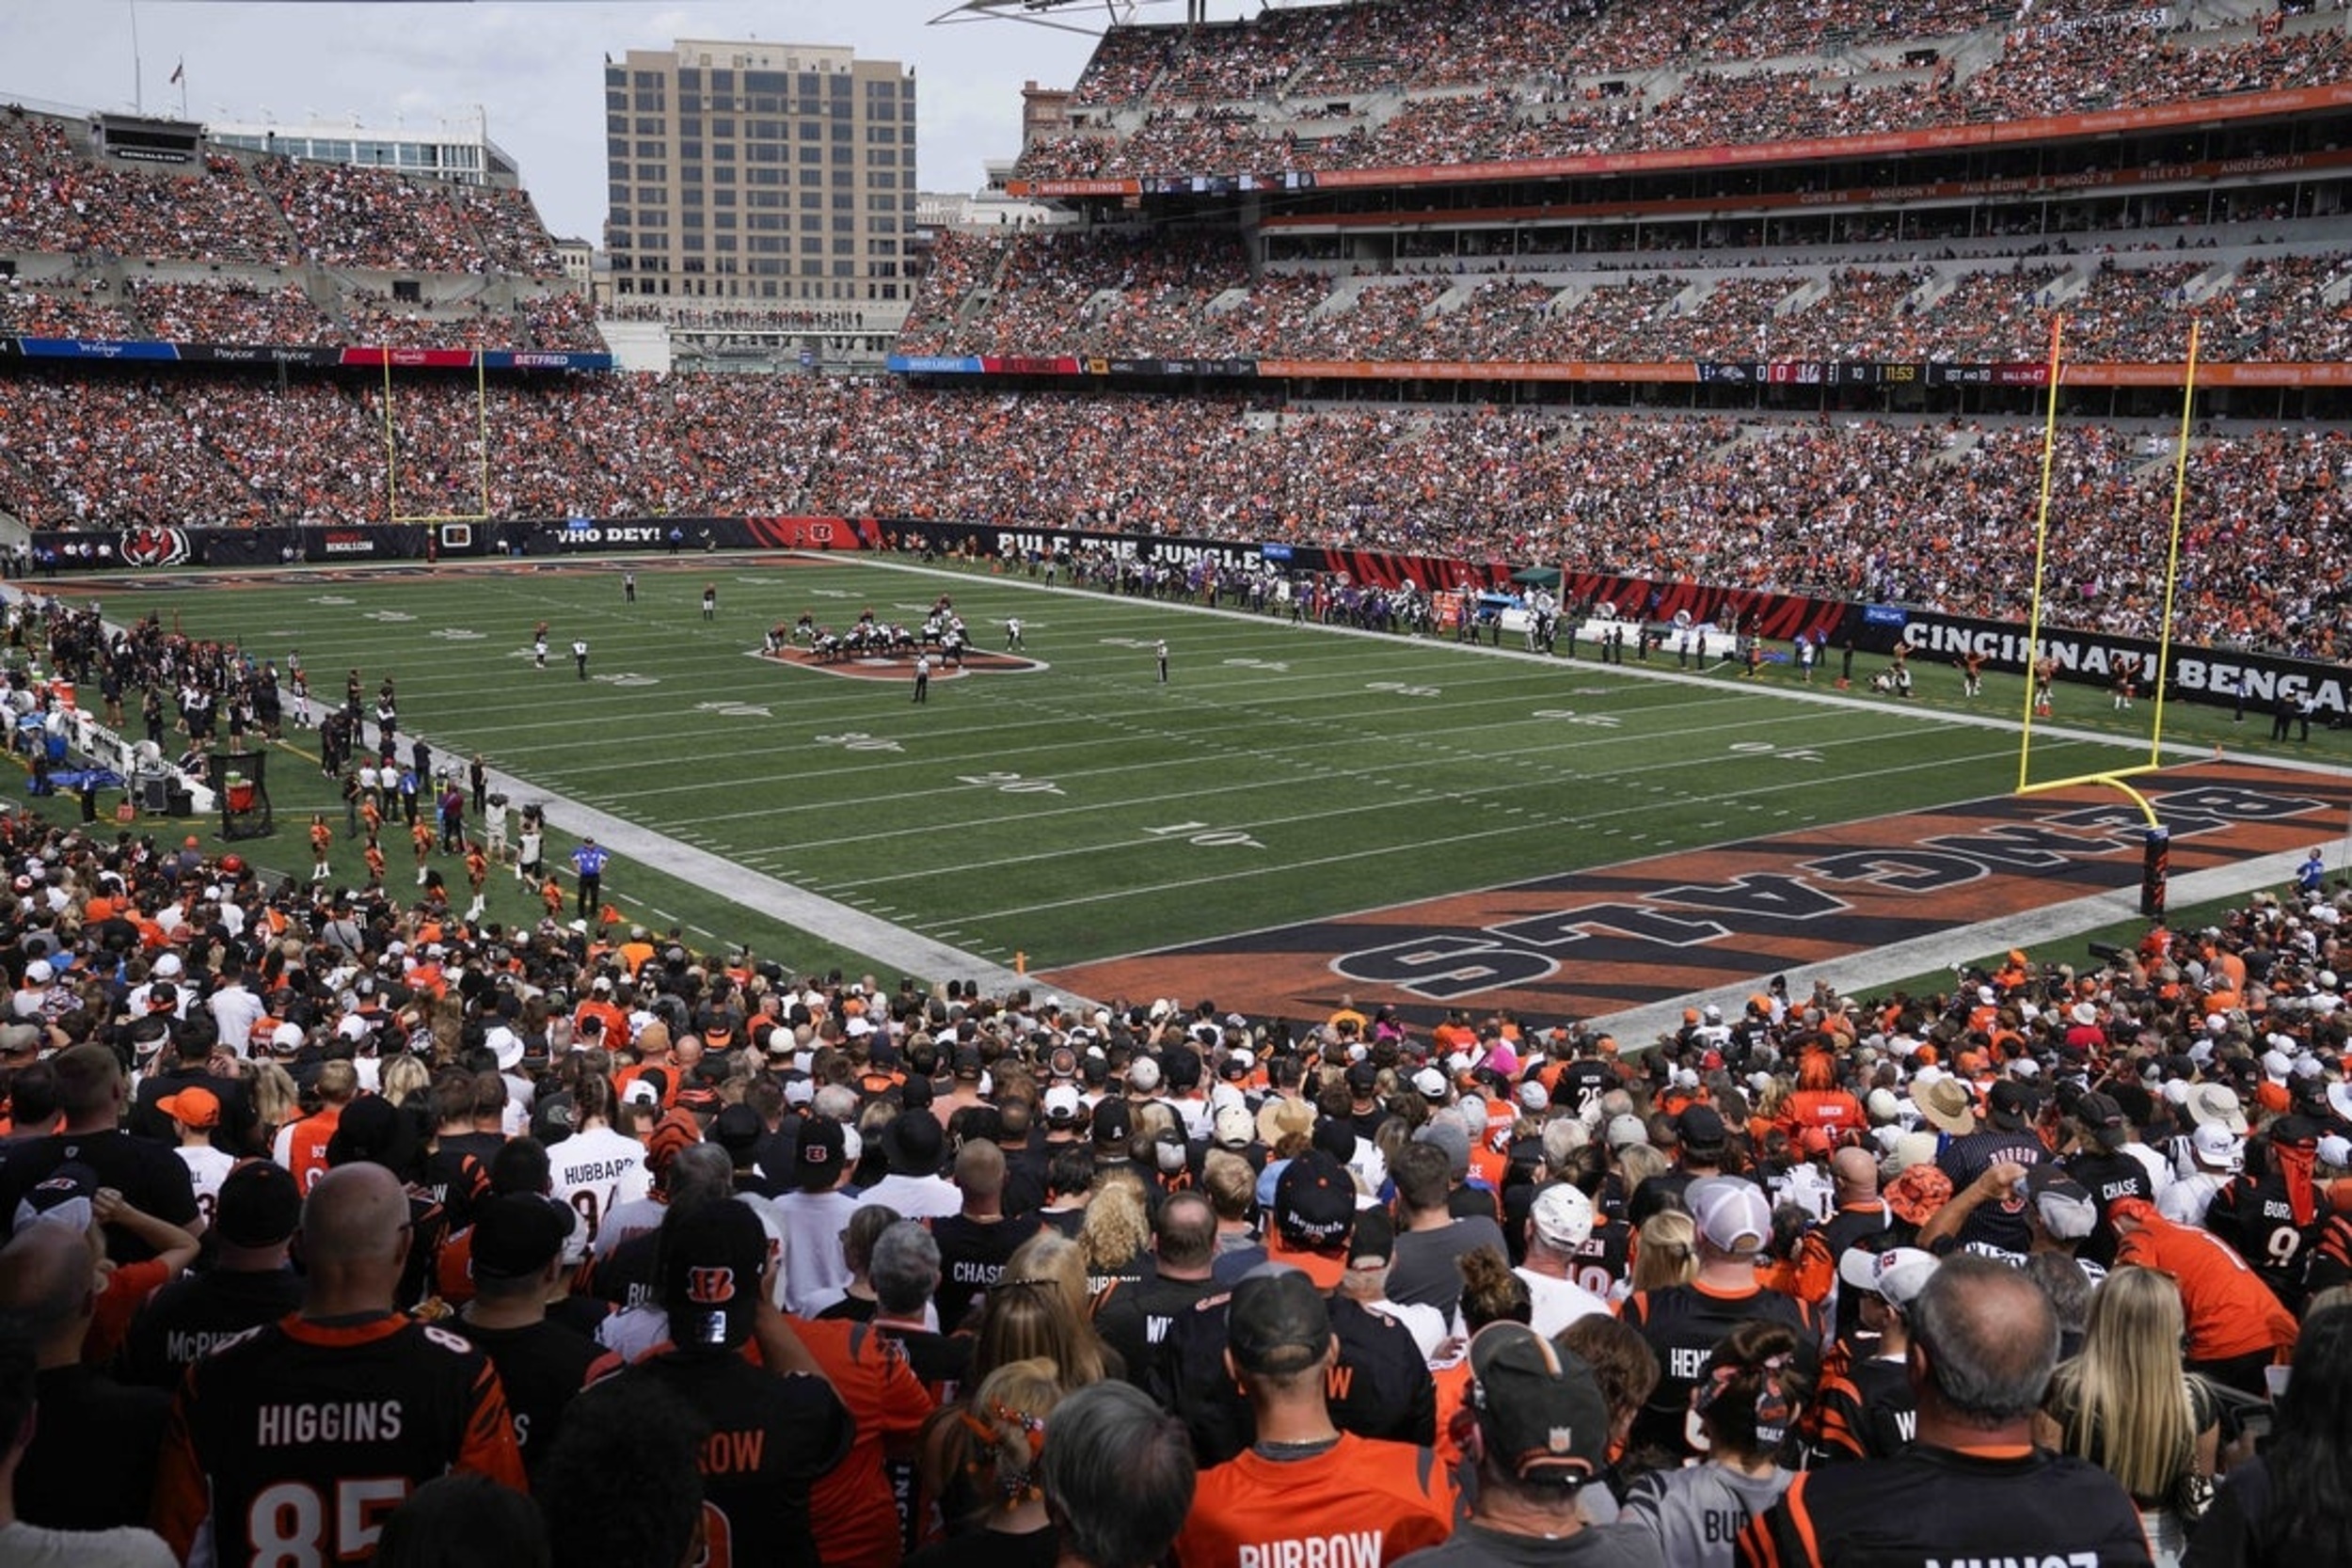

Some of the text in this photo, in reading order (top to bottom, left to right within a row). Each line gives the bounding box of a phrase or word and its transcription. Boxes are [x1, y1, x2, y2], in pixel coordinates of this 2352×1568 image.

[2138, 168, 2174, 180] RILEY
[2220, 155, 2305, 173] ANDERSON 71
[214, 347, 256, 359] Paycor
[271, 348, 312, 361] Paycor
[515, 354, 569, 365] BETFRED
[1885, 367, 1915, 381] 11:53
[2032, 369, 2045, 382] 47
[606, 527, 660, 542] DEY!
[1149, 544, 1261, 571] JUNGLE
[1902, 622, 2352, 715] CINCINNATI BENGA
[1141, 820, 1268, 850] 10
[1329, 785, 2331, 1000] BENGALS
[2102, 1176, 2140, 1200] CHASE
[1288, 1209, 1344, 1235] Bengals
[2264, 1225, 2302, 1268] 9
[258, 1400, 403, 1448] HIGGINS
[246, 1476, 412, 1568] 85
[1238, 1530, 1383, 1568] BURROW
